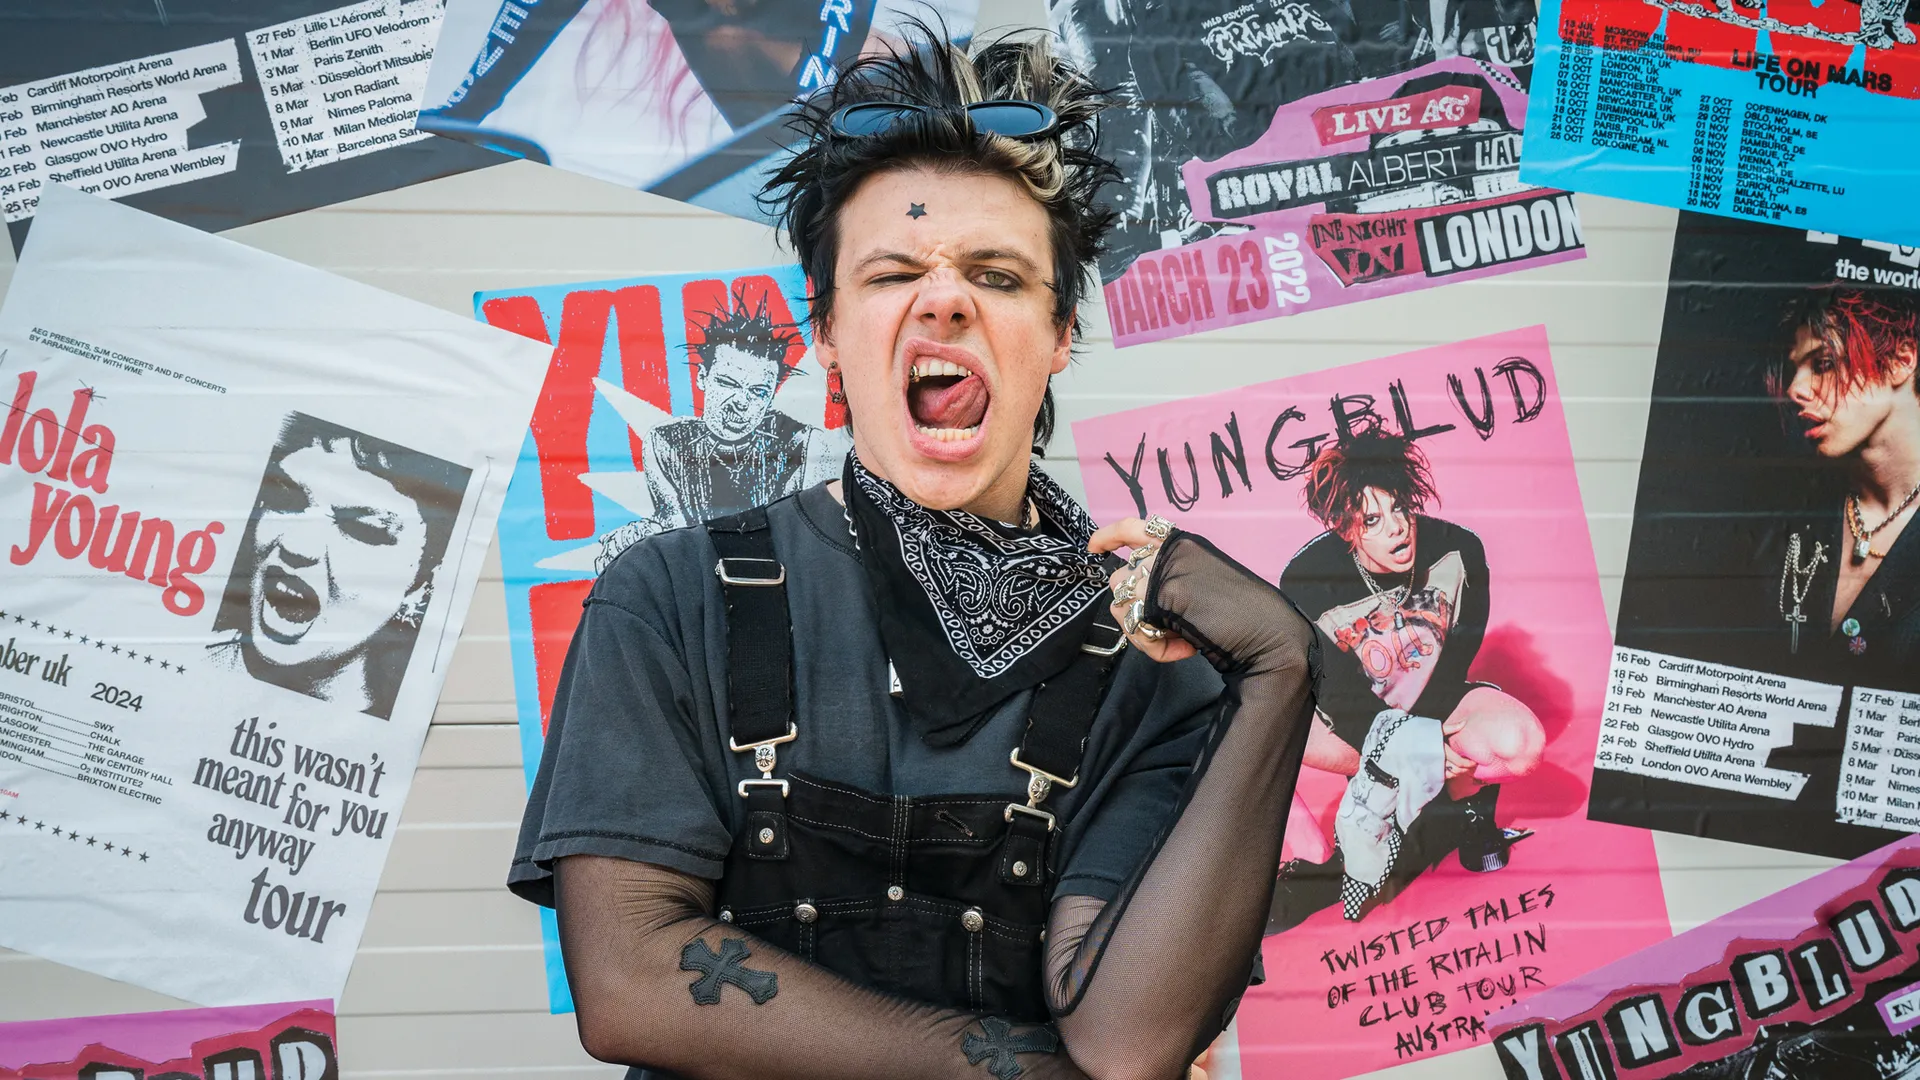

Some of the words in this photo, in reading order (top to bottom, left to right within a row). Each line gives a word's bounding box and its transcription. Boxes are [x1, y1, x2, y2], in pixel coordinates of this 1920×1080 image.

[256, 33, 269, 45] 27
[272, 28, 296, 41] Feb
[304, 21, 328, 33] Lille
[261, 52, 268, 61] 1
[270, 47, 294, 59] Mar
[308, 36, 344, 50] Berlin
[345, 28, 372, 41] UFO
[373, 17, 430, 35] Velodrom
[265, 69, 274, 78] 3
[275, 64, 299, 76] Mar
[314, 53, 344, 67] Paris
[345, 44, 383, 60] Zenith
[1560, 53, 1569, 61] 01
[1573, 55, 1593, 65] OCT
[1601, 60, 1643, 74] LONDON,
[1646, 67, 1659, 76] UK
[1732, 48, 1780, 71] LIFE
[1786, 58, 1820, 79] ON
[1826, 62, 1892, 91] MARS
[275, 103, 284, 113] 8
[285, 99, 309, 111] Mar
[323, 89, 352, 102] Lyon
[354, 76, 400, 95] Radiant
[1558, 70, 1569, 78] 07
[1571, 72, 1591, 82] OCT
[1599, 77, 1665, 96] MANCHESTER,
[1669, 88, 1681, 96] UK
[1755, 71, 1817, 98] TOUR
[280, 121, 288, 131] 9
[290, 116, 313, 128] Mar
[368, 93, 412, 110] Paloma
[1332, 102, 1412, 136] LIVE
[1700, 95, 1711, 103] 27
[1713, 97, 1733, 106] OCT
[1746, 103, 1811, 122] COPENHAGEN,
[1814, 114, 1827, 123] DK
[1695, 129, 1706, 138] 02
[1708, 131, 1728, 141] NOV
[1741, 137, 1789, 153] HAMBURG,
[1793, 146, 1805, 154] DE
[2, 186, 15, 196] 24
[18, 178, 40, 192] Feb
[49, 163, 103, 183] Sheffield
[104, 157, 139, 171] Utilita
[142, 148, 177, 163] Arena
[1215, 161, 1341, 210] ROYAL
[1348, 146, 1461, 190] ALBERT
[1687, 197, 1697, 206] 20
[1700, 200, 1720, 209] NOV
[1733, 204, 1769, 218] DUBLIN,
[1349, 219, 1407, 243] NIGHT
[1422, 195, 1585, 273] LONDON
[1218, 240, 1269, 315] 23
[1264, 232, 1311, 307] 2022
[1836, 259, 1869, 281] the
[1874, 268, 1920, 289] worl
[29, 334, 40, 342] BY
[41, 339, 101, 361] ARRANGEMENT
[103, 358, 122, 368] WITH
[124, 364, 143, 375] WME
[32, 327, 48, 336] AEG
[49, 332, 91, 351] PRESENTS,
[93, 346, 110, 356] SJM
[111, 352, 154, 370] CONCERTS
[154, 366, 171, 376] AND
[185, 376, 226, 394] CONCERTS
[0, 371, 116, 494] lola
[1104, 357, 1546, 520] YUNGBLUD
[10, 482, 225, 617] young
[42, 654, 73, 687] uk
[91, 682, 143, 712] 2024
[1616, 652, 1628, 662] 16
[1630, 654, 1650, 666] Feb
[1659, 659, 1694, 673] Cardiff
[1696, 665, 1754, 684] Motorpoint
[1755, 675, 1786, 689] Arena
[1612, 685, 1623, 695] 19
[1626, 687, 1645, 698] Feb
[1653, 692, 1716, 710] Manchester
[1717, 703, 1734, 713] AO
[1736, 706, 1767, 719] Arena
[1614, 669, 1626, 679] 18
[1628, 671, 1648, 682] Feb
[1656, 675, 1719, 694] Birmingham
[1722, 686, 1762, 701] Resorts
[1765, 693, 1795, 707] World
[1797, 699, 1827, 712] Arena
[93, 721, 114, 732] SWX
[1604, 718, 1618, 728] 22
[1620, 720, 1639, 731] Feb
[1647, 725, 1694, 741] Glasgow
[1696, 732, 1720, 745] OVO
[1723, 737, 1754, 750] Hydro
[1608, 702, 1619, 712] 21
[1623, 704, 1642, 715] Feb
[1651, 708, 1705, 725] Newcastle
[1708, 717, 1737, 731] Utilita
[1739, 723, 1770, 736] Arena
[88, 742, 105, 753] THE
[107, 748, 144, 765] GARAGE
[90, 731, 121, 746] CHALK
[230, 717, 285, 768] this
[1602, 734, 1614, 744] 24
[1617, 737, 1637, 748] Feb
[1644, 740, 1691, 757] Sheffield
[1693, 749, 1722, 762] Utilita
[1724, 754, 1755, 767] Arena
[84, 753, 105, 764] NEW
[107, 760, 149, 777] CENTURY
[151, 773, 173, 786] HALL
[93, 767, 143, 788] INSTITUTE2
[1598, 751, 1612, 760] 25
[1614, 753, 1634, 764] Feb
[1641, 757, 1681, 772] London
[1684, 764, 1709, 776] OVO
[1710, 769, 1741, 782] Arena
[1744, 774, 1792, 792] Wembley
[77, 773, 116, 791] BRIXTON
[118, 786, 162, 804] ELECTRIC
[193, 757, 286, 809] meant
[283, 782, 330, 832] for
[332, 800, 388, 839] you
[1844, 790, 1856, 800] 10
[1858, 792, 1878, 803] Mar
[1887, 796, 1914, 809] Milan
[208, 814, 316, 876] anyway
[244, 867, 347, 943] tour
[1321, 917, 1450, 975] TWISTED
[1464, 884, 1555, 930] TALES
[1328, 982, 1356, 1009] OF
[1365, 964, 1419, 996] THE
[1427, 923, 1546, 979] RITALIN
[1503, 877, 1920, 1080] YUNGBLUD
[1360, 991, 1446, 1027] CLUB
[1458, 966, 1546, 1003] TOUR
